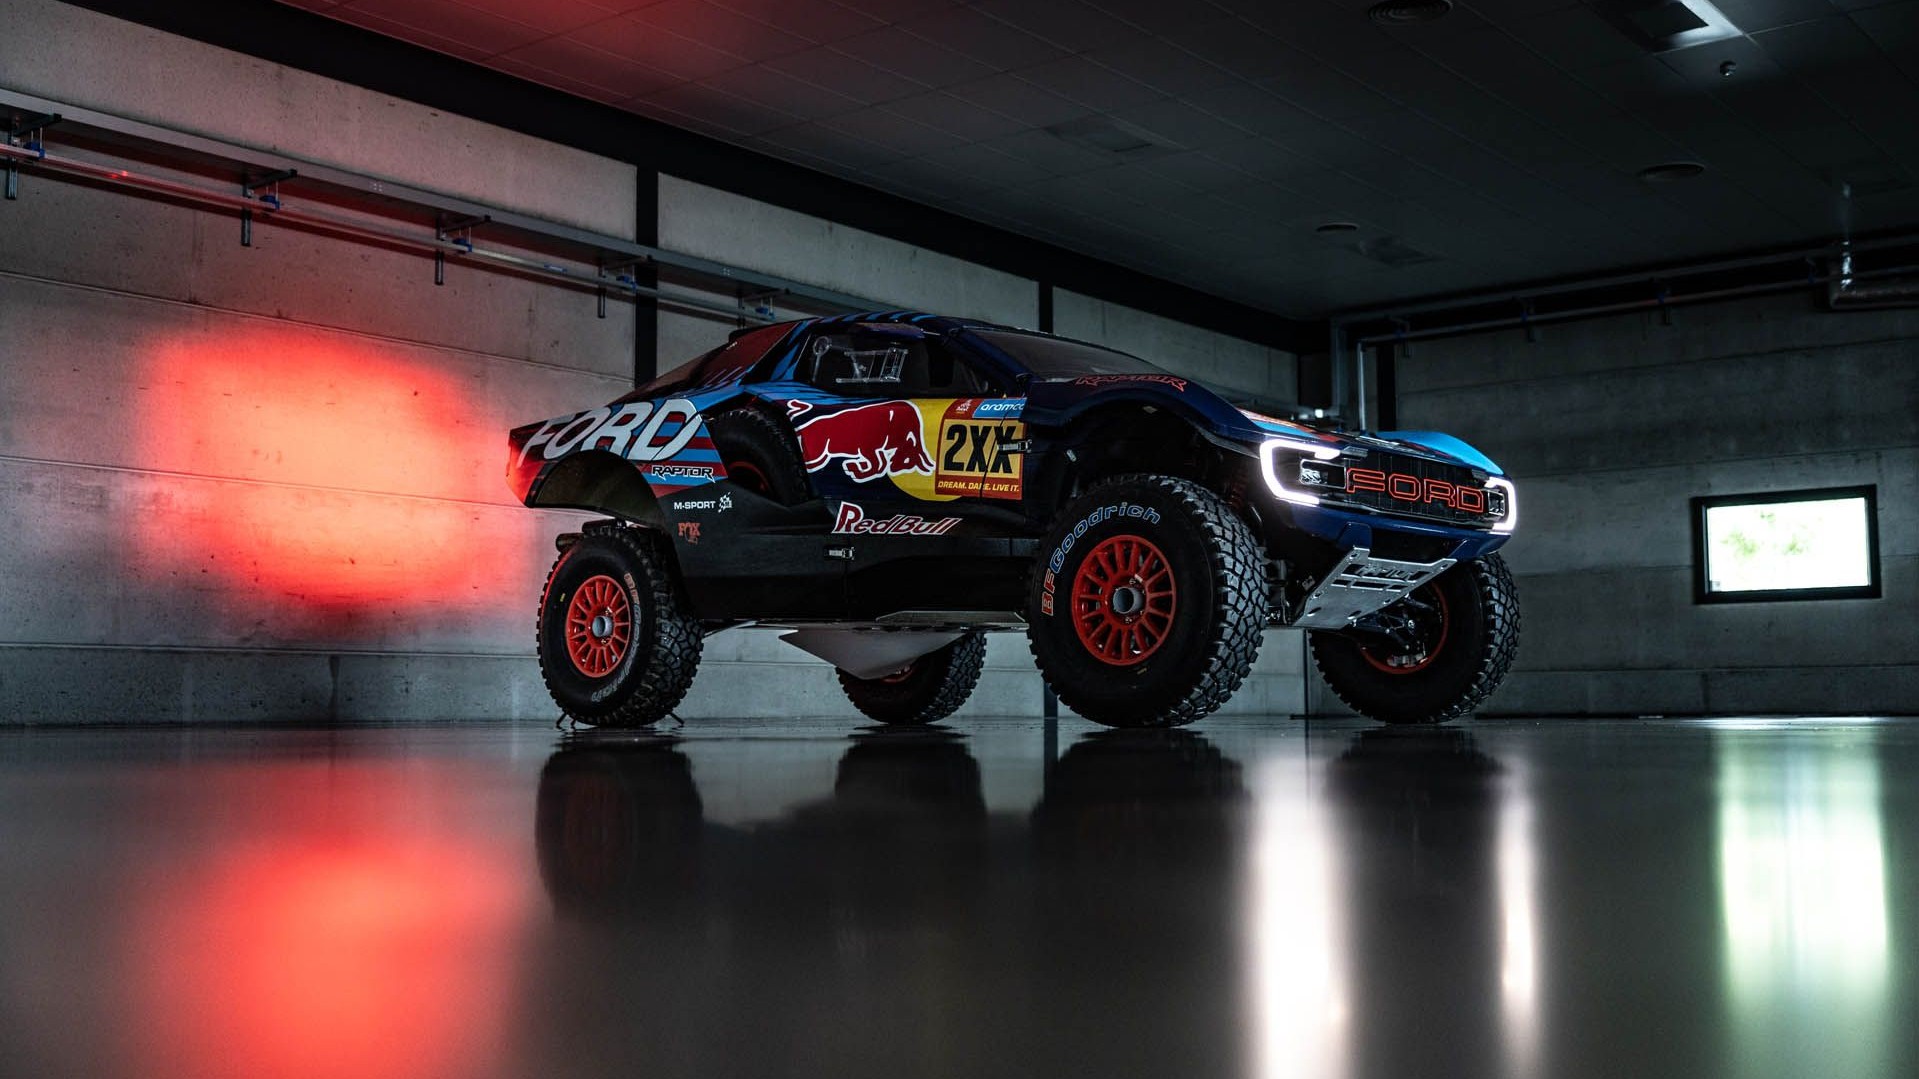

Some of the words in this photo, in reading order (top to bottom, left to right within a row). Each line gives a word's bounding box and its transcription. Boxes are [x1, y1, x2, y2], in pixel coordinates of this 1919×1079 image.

[517, 399, 703, 468] FORD
[943, 424, 1016, 474] 2XX
[652, 465, 715, 483] RAPTOR
[938, 481, 967, 490] DREAM.
[992, 484, 1009, 492] LIVE
[1010, 484, 1020, 492] IT.
[1346, 467, 1484, 513] FORD
[673, 501, 716, 510] M-SPORT
[1041, 502, 1161, 616] BFGoodrich
